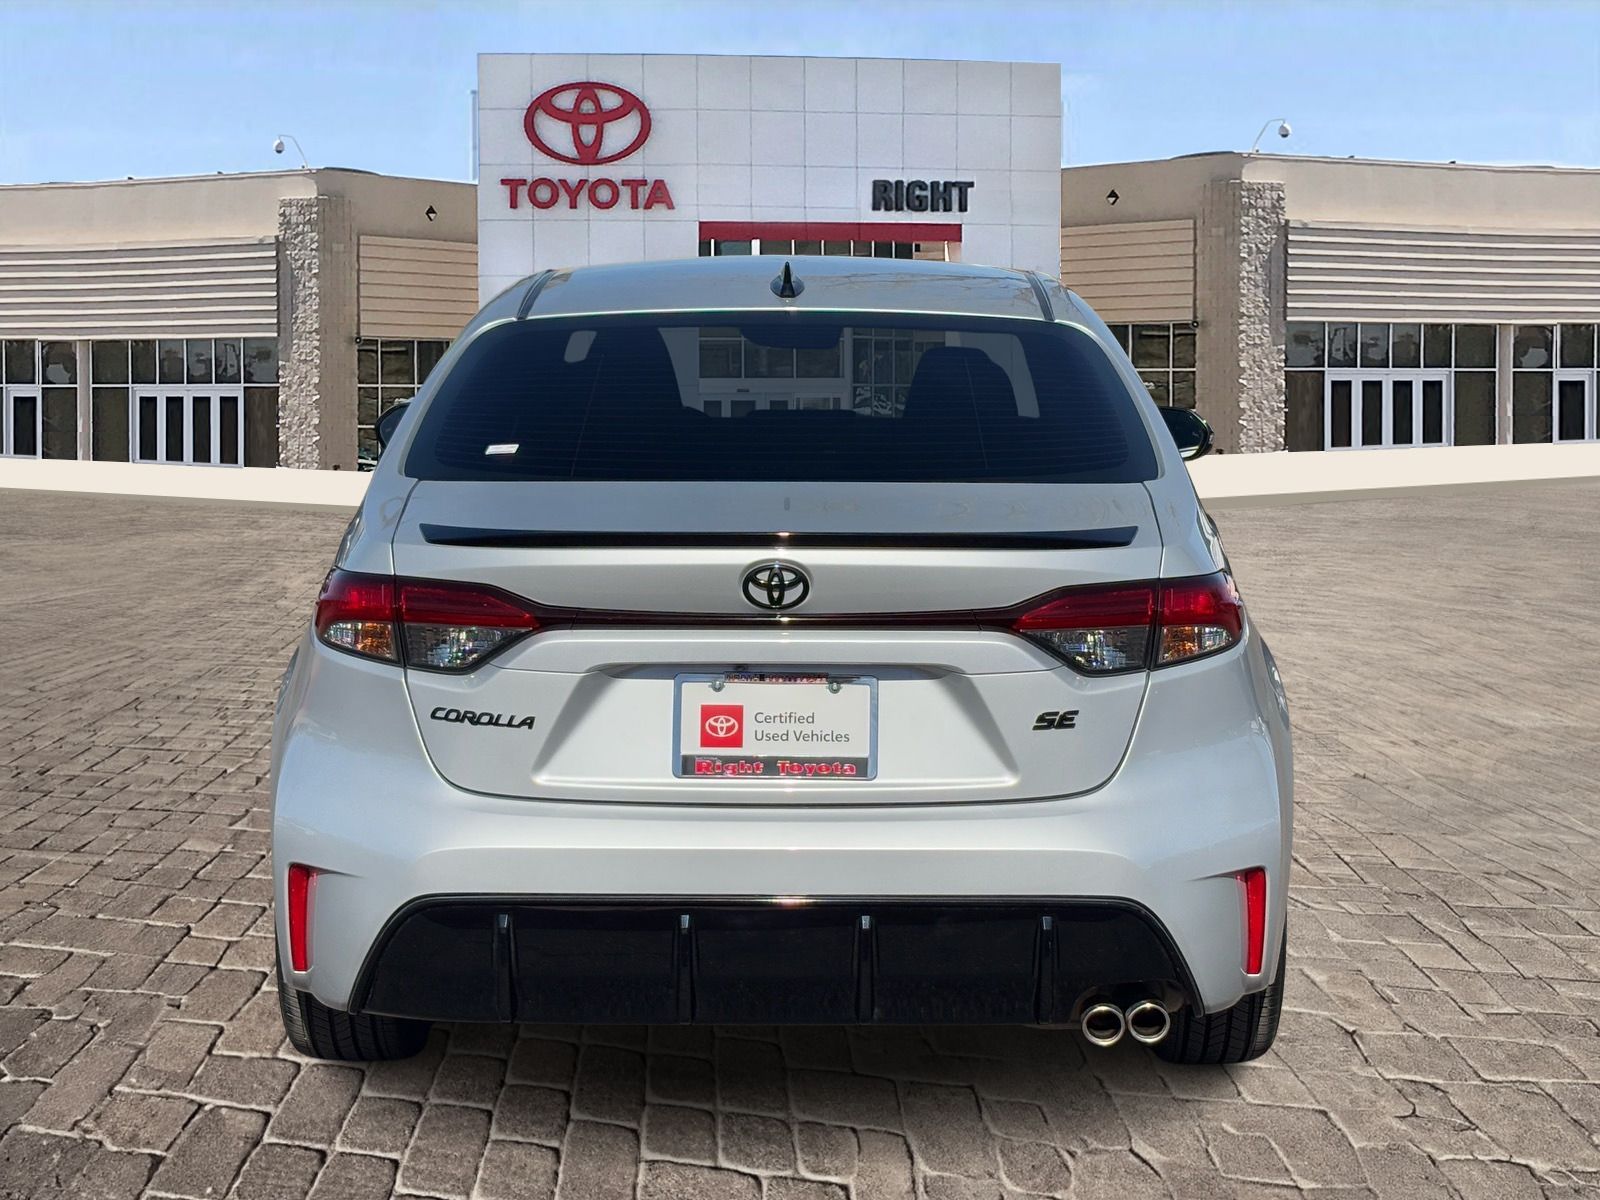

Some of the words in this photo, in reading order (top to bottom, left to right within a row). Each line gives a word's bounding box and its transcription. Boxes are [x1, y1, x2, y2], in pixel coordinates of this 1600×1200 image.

[500, 178, 675, 210] TOYOTA
[871, 179, 975, 213] RIGHT
[430, 706, 536, 730] COROLLA
[754, 712, 815, 724] Certified
[1031, 709, 1080, 731] SE
[754, 730, 789, 742] Used
[793, 730, 850, 742] Vehicles
[694, 758, 764, 776] Right
[776, 760, 857, 777] Toyota
